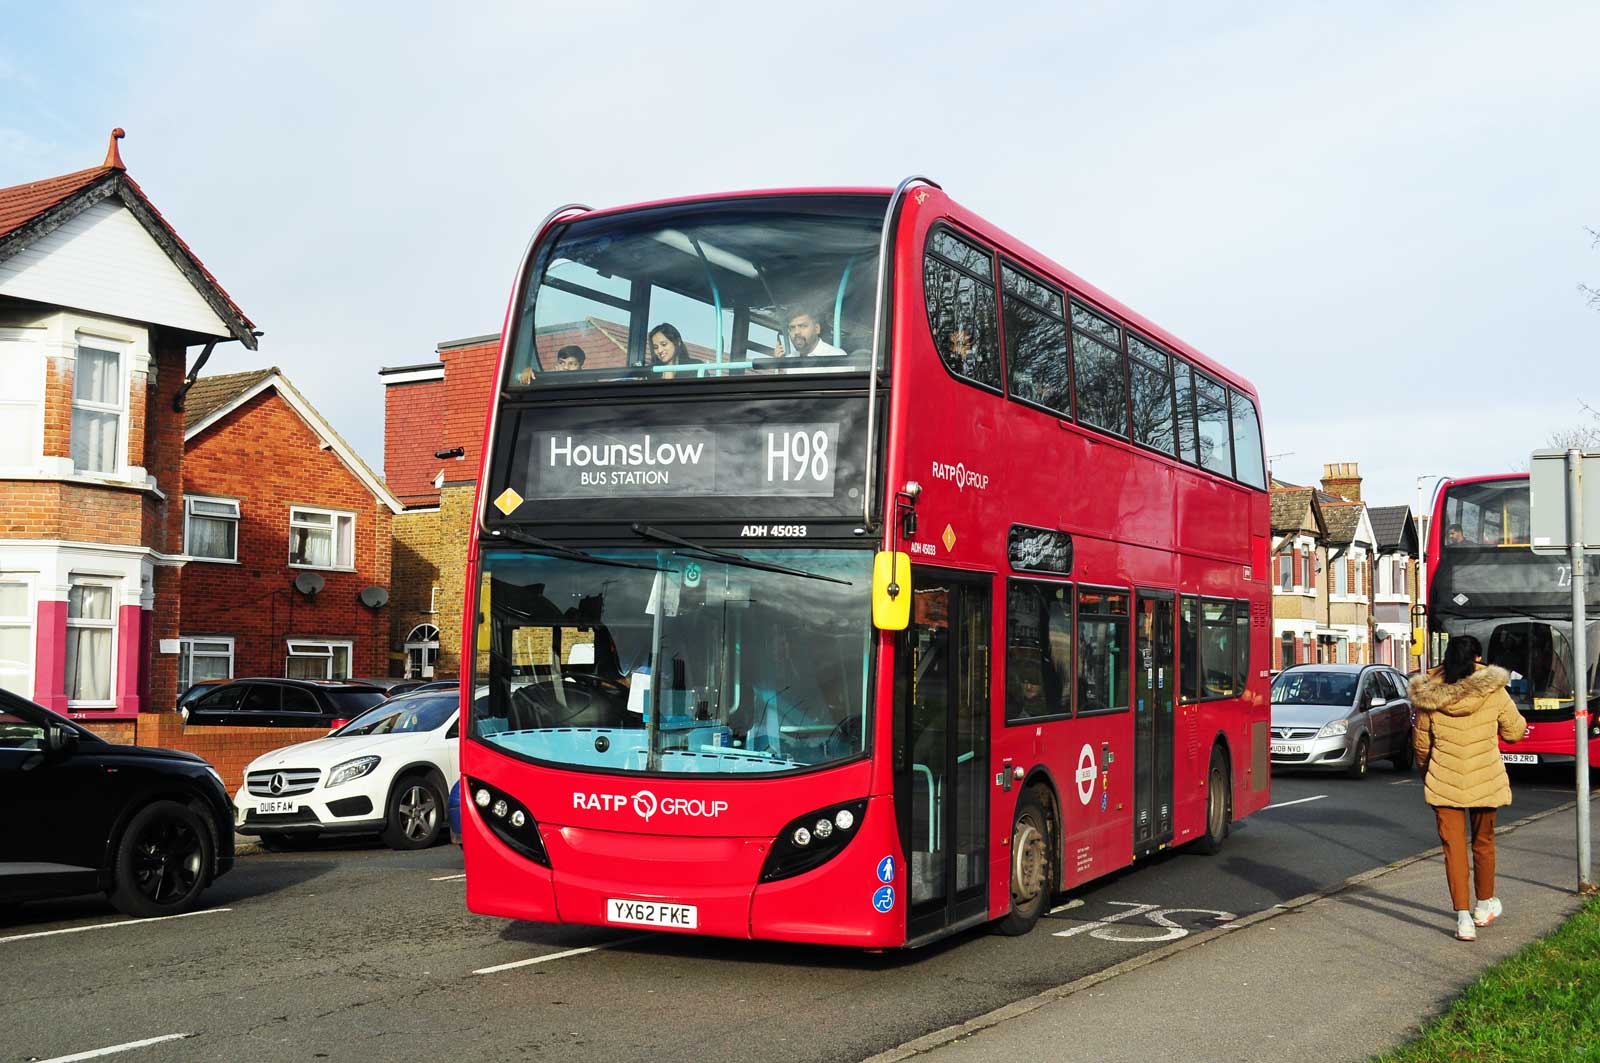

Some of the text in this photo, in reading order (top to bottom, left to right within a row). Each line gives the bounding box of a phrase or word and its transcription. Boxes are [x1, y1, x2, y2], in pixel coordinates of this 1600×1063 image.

[550, 435, 704, 467] Hounslow
[767, 430, 829, 481] H98
[581, 471, 669, 485] BUS STATION
[932, 461, 988, 489] RATP GROUP
[741, 525, 806, 537] ADH 45033
[277, 801, 293, 811] FAM
[573, 792, 728, 817] RATP GROUP
[615, 902, 690, 924] YX62 FKE
